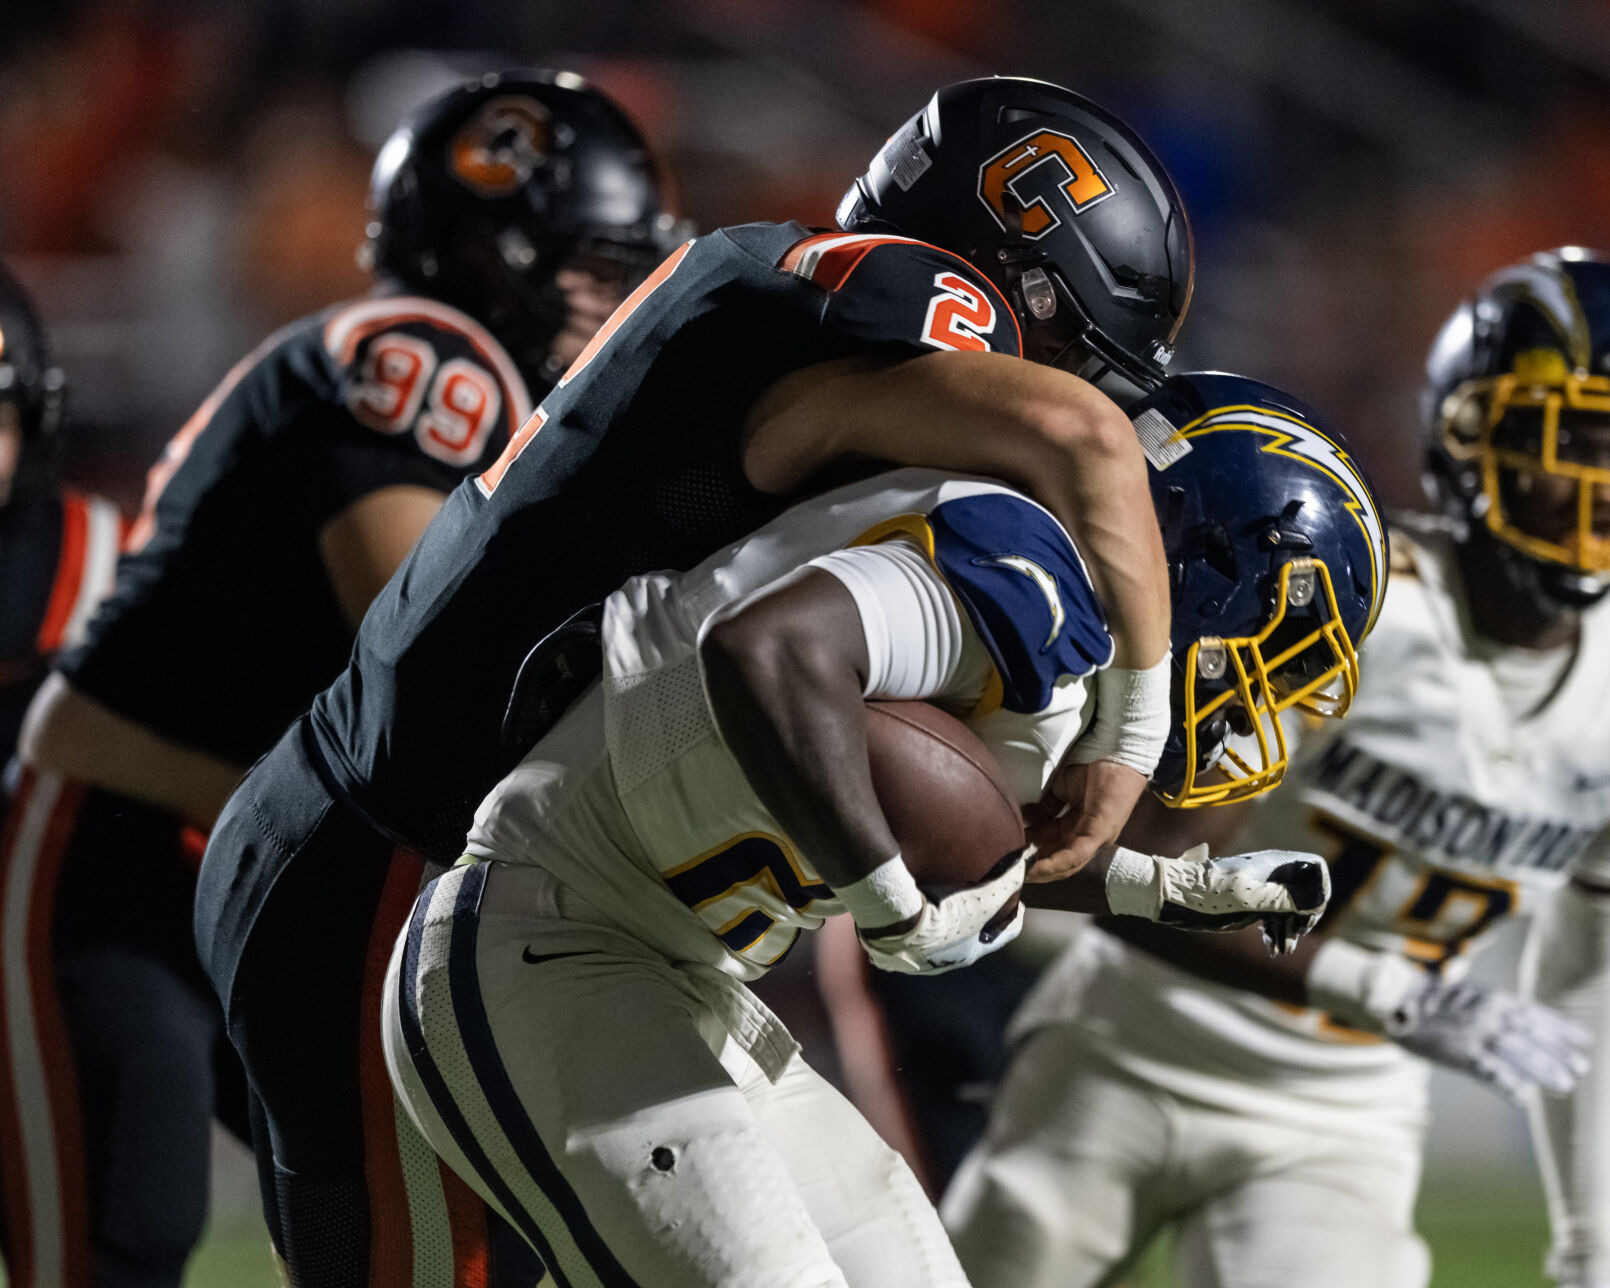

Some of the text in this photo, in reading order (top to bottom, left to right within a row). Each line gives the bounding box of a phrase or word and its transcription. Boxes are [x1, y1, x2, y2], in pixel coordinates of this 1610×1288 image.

[977, 127, 1116, 241] C
[920, 271, 997, 353] 2
[346, 332, 501, 468] 99
[1305, 735, 1528, 867] MADISON
